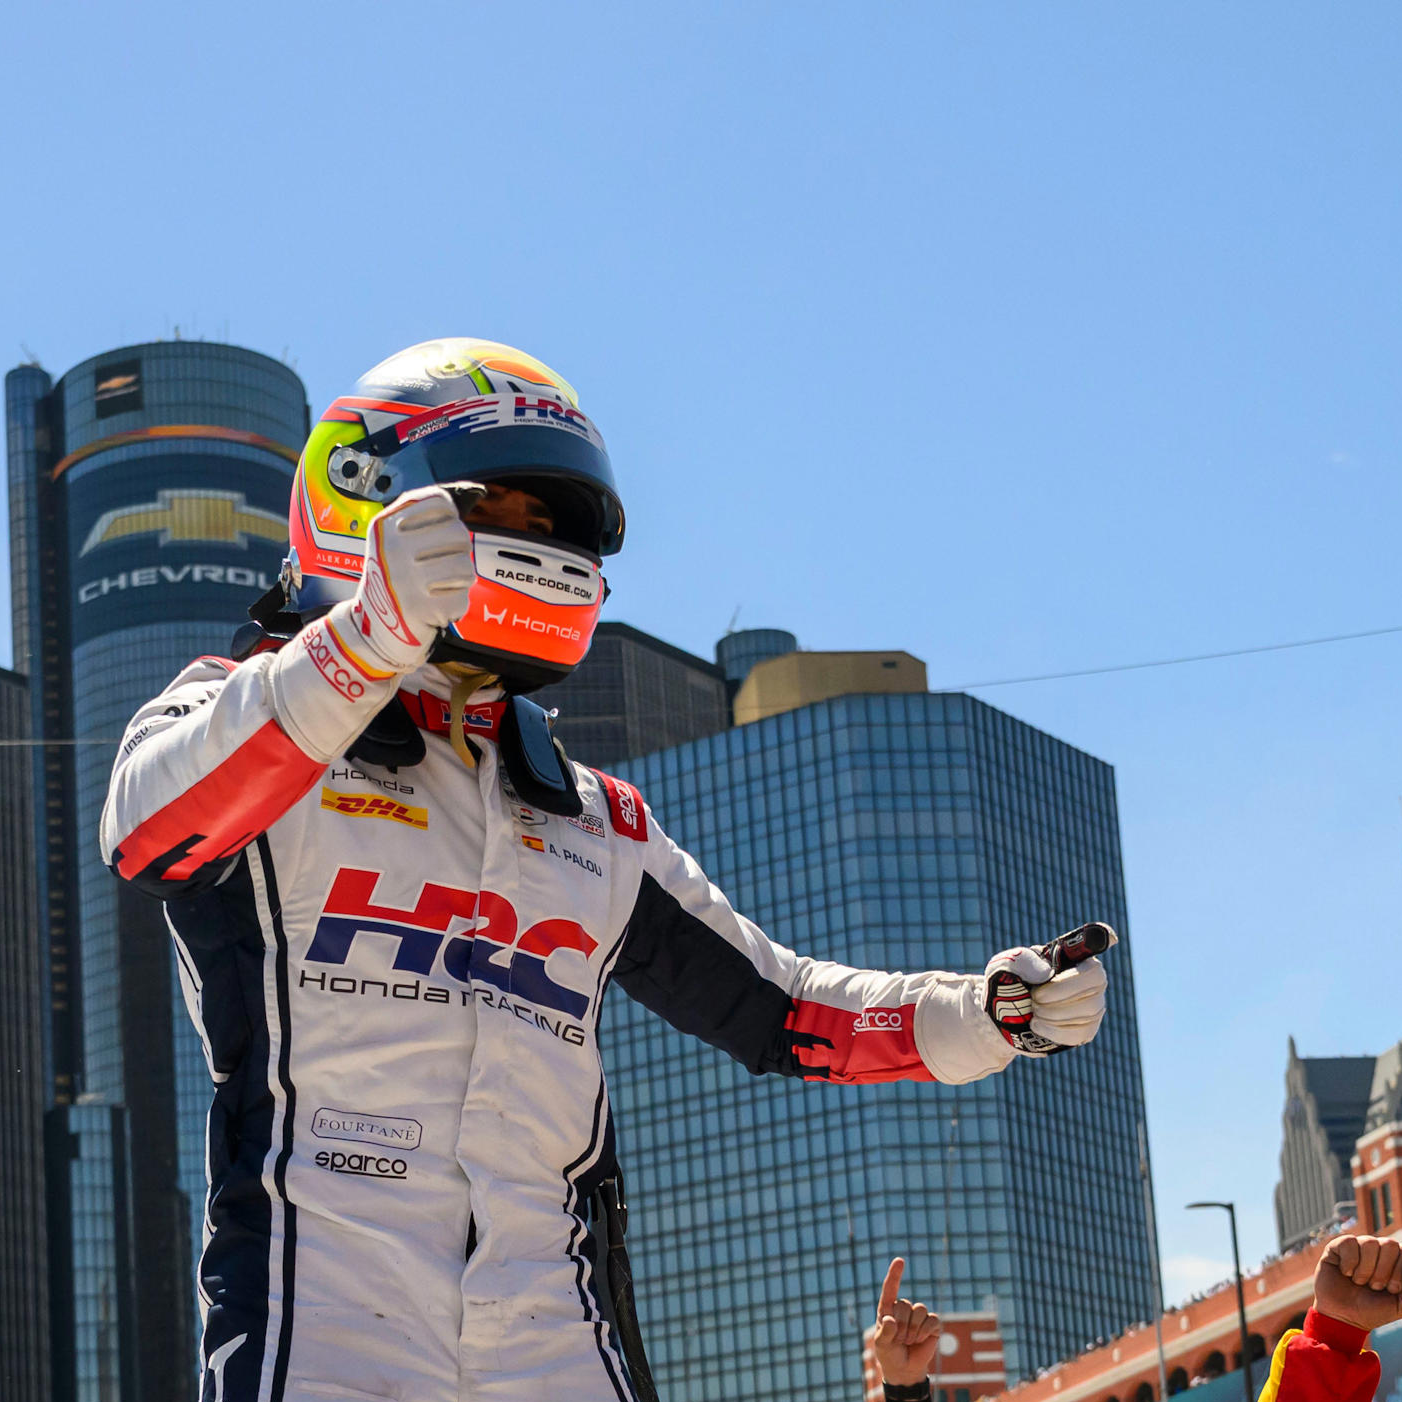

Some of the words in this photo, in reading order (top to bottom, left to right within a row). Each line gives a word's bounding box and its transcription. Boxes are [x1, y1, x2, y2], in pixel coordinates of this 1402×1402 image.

[514, 397, 589, 432] HRC
[315, 553, 342, 566] ALEX
[78, 563, 281, 604] CHEVROL
[512, 612, 581, 641] Honda
[302, 624, 365, 702] sparco
[331, 768, 415, 796] Honda
[335, 796, 415, 823] DHL
[549, 842, 561, 858] A.
[563, 849, 603, 877] PALOU
[303, 866, 599, 1021] HRC
[299, 970, 450, 1004] Honda
[461, 988, 586, 1047] RACING
[318, 1118, 416, 1141] FOURTANÉ
[314, 1151, 408, 1176] sparco
